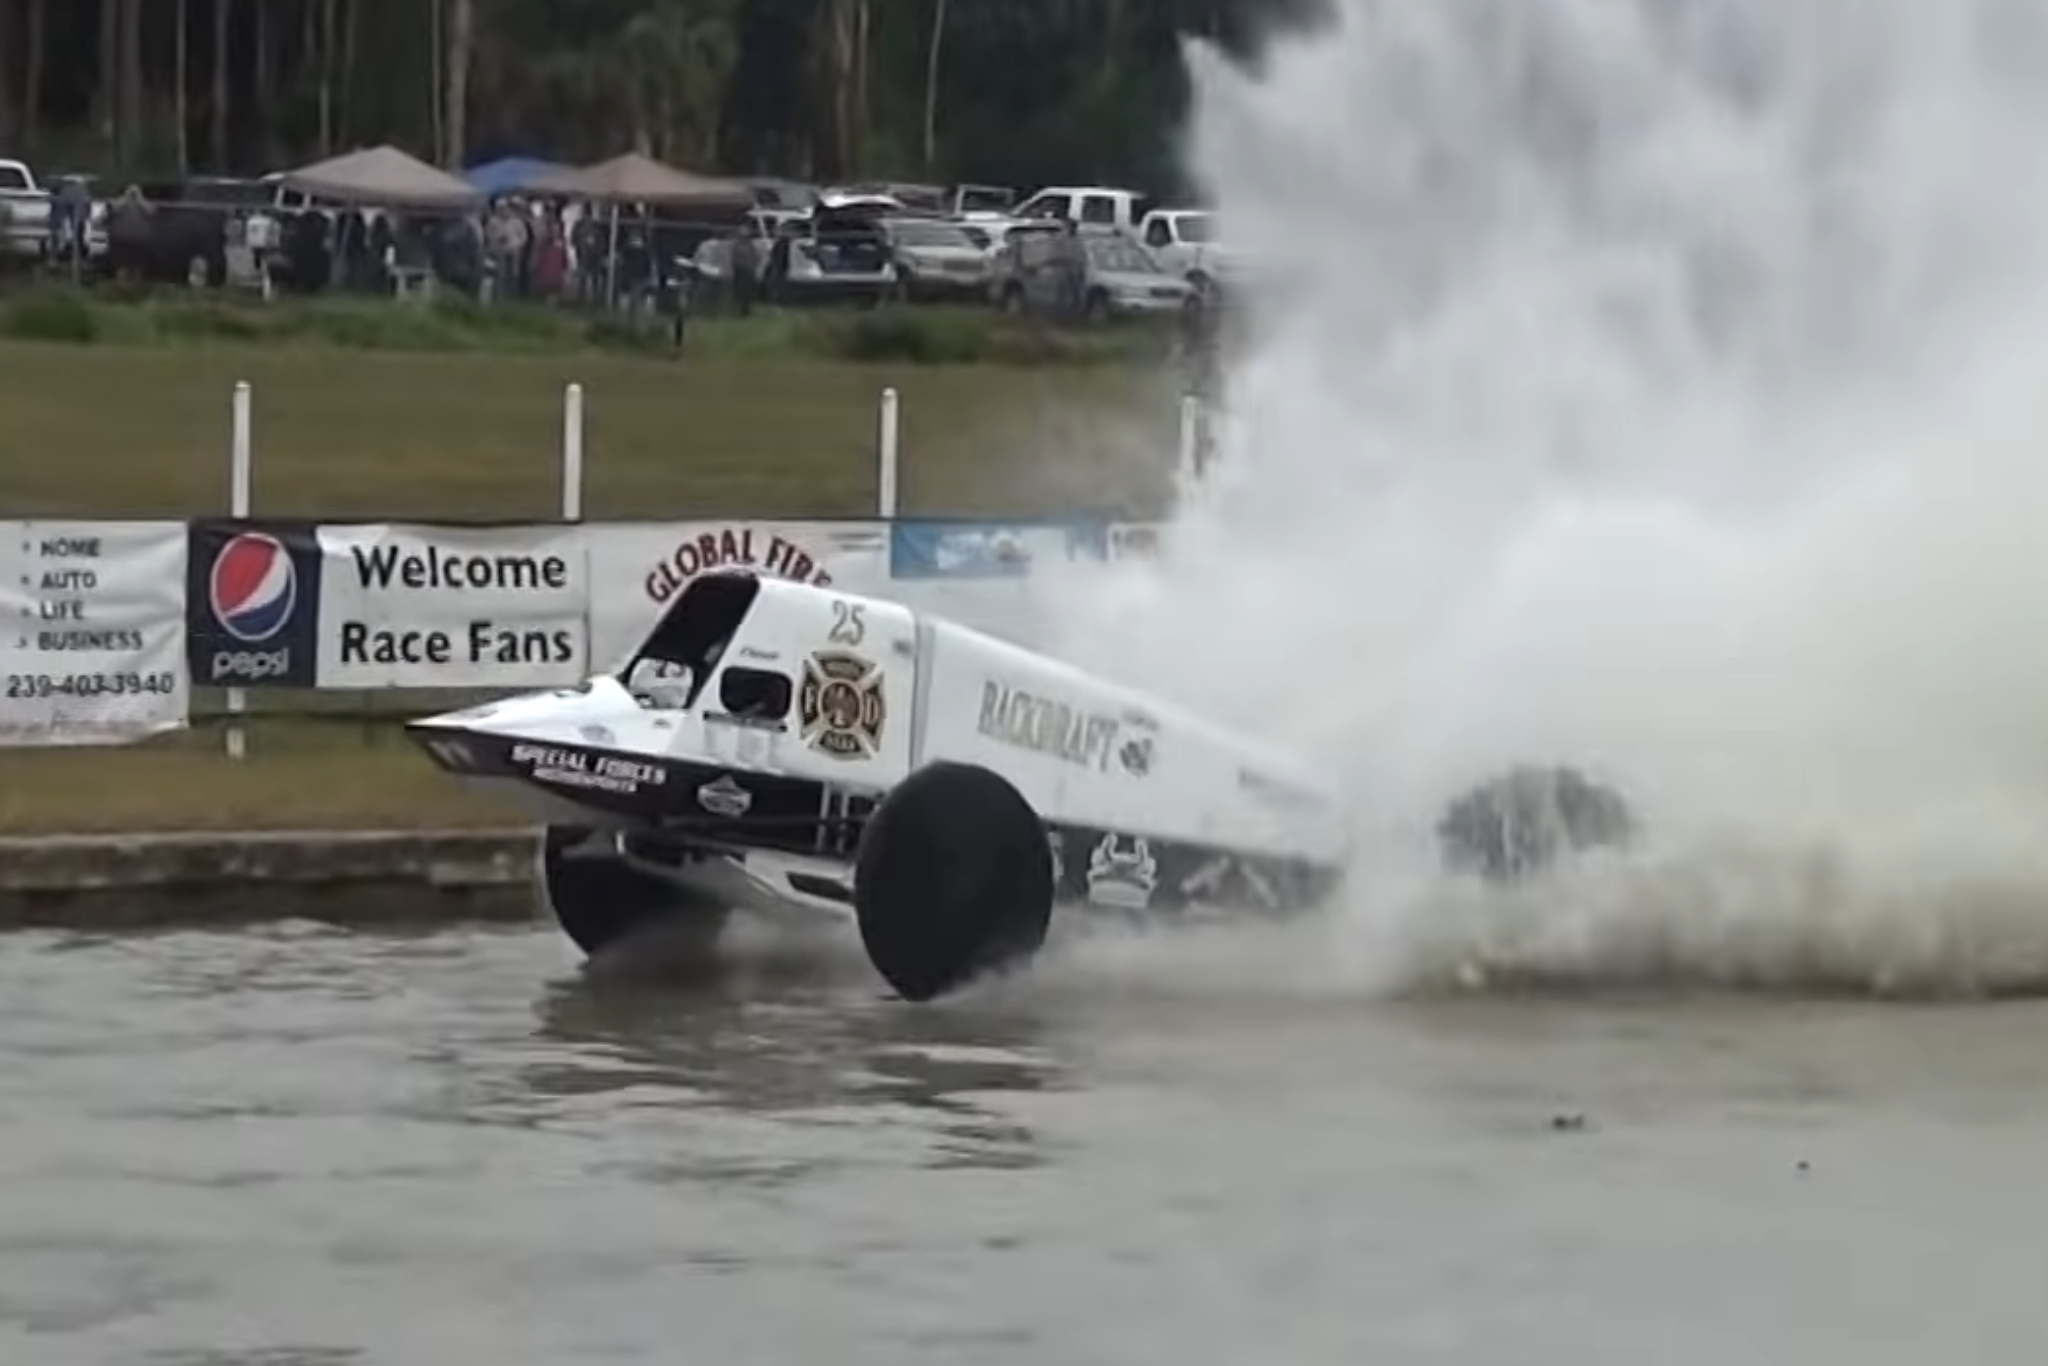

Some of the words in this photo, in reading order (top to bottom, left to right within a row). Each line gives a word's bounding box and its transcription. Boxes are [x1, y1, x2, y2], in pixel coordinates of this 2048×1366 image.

[40, 538, 101, 558] HOME
[40, 570, 97, 589] AUTO
[352, 545, 566, 588] Welcome
[645, 529, 756, 604] GLOBAL
[40, 600, 85, 620] LIFE
[827, 600, 866, 646] 25
[38, 631, 143, 651] BUSINESS
[340, 622, 449, 664] Race
[468, 621, 573, 664] Fans
[212, 649, 289, 679] pepsi
[6, 672, 175, 698] 239-403-3940
